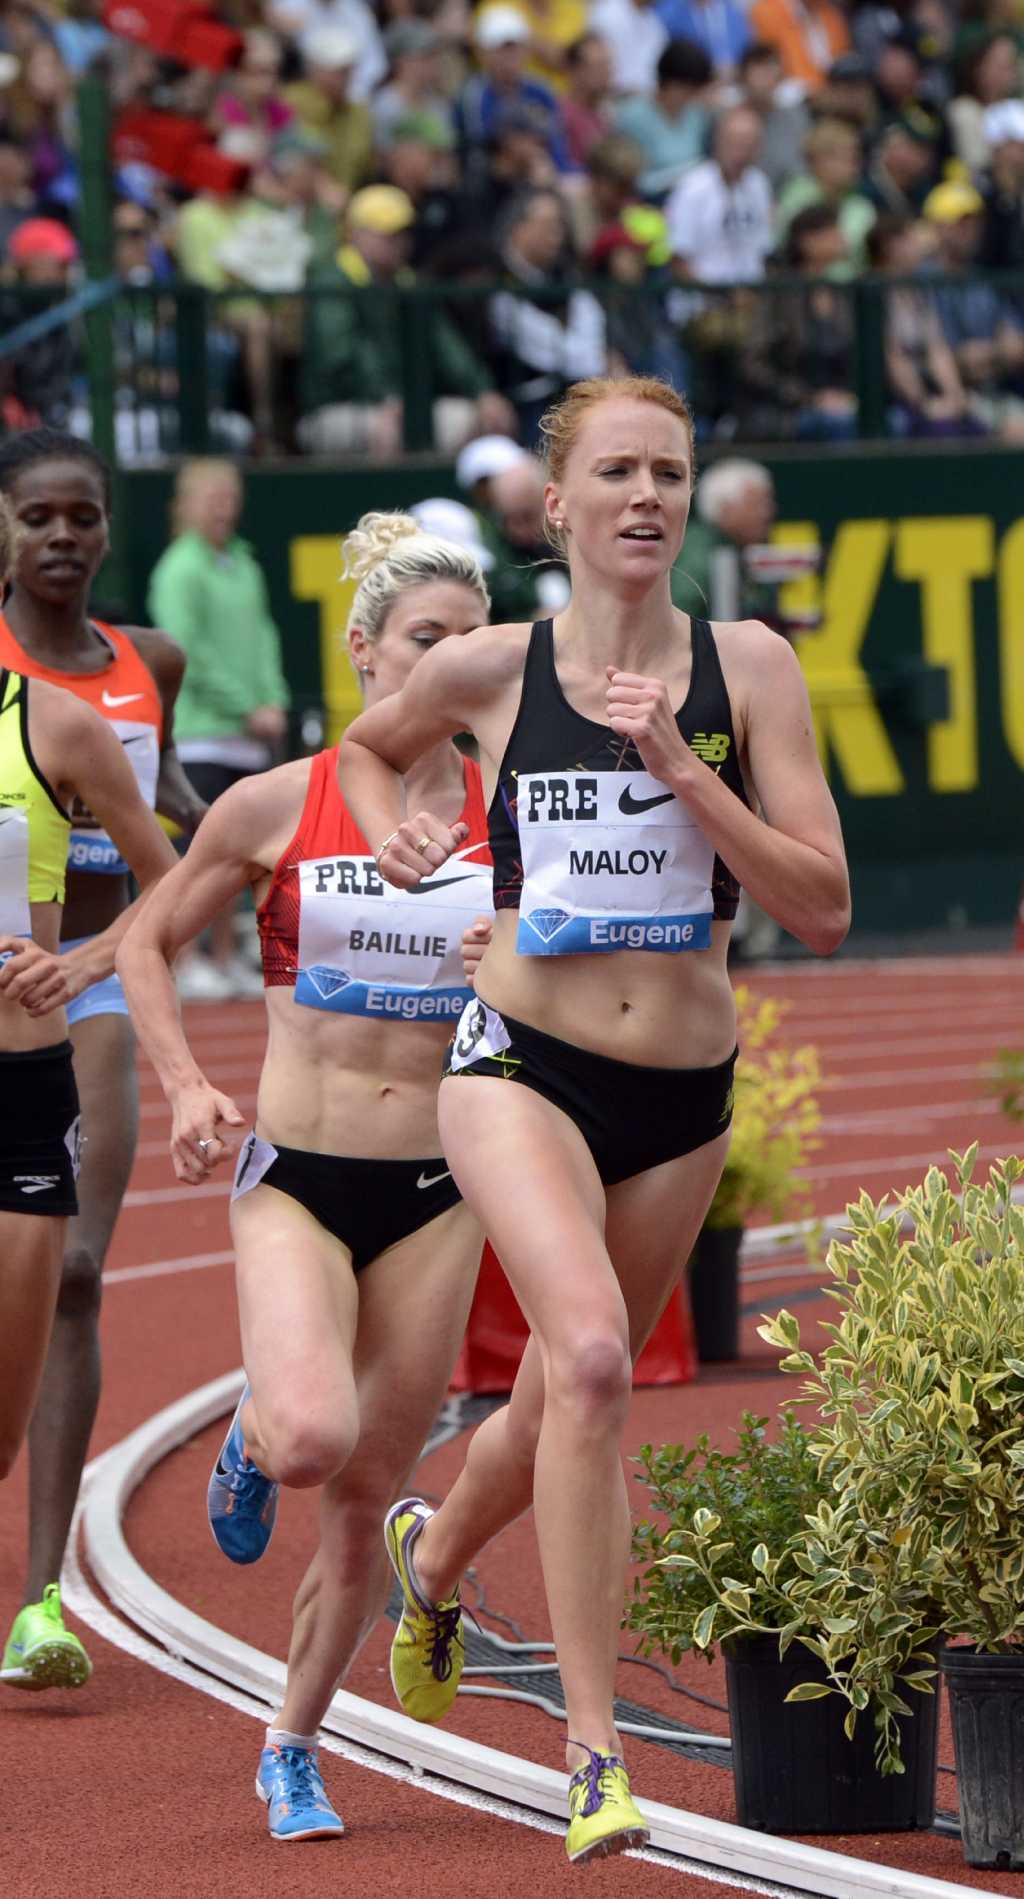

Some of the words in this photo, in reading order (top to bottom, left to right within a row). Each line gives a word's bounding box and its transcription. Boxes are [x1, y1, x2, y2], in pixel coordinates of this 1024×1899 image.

[528, 778, 598, 822] PRE
[569, 849, 667, 876] MALOY
[314, 860, 384, 897] PRE
[348, 929, 447, 958] BAILLIE
[589, 919, 694, 948] Eugene
[364, 987, 464, 1019] Eugene
